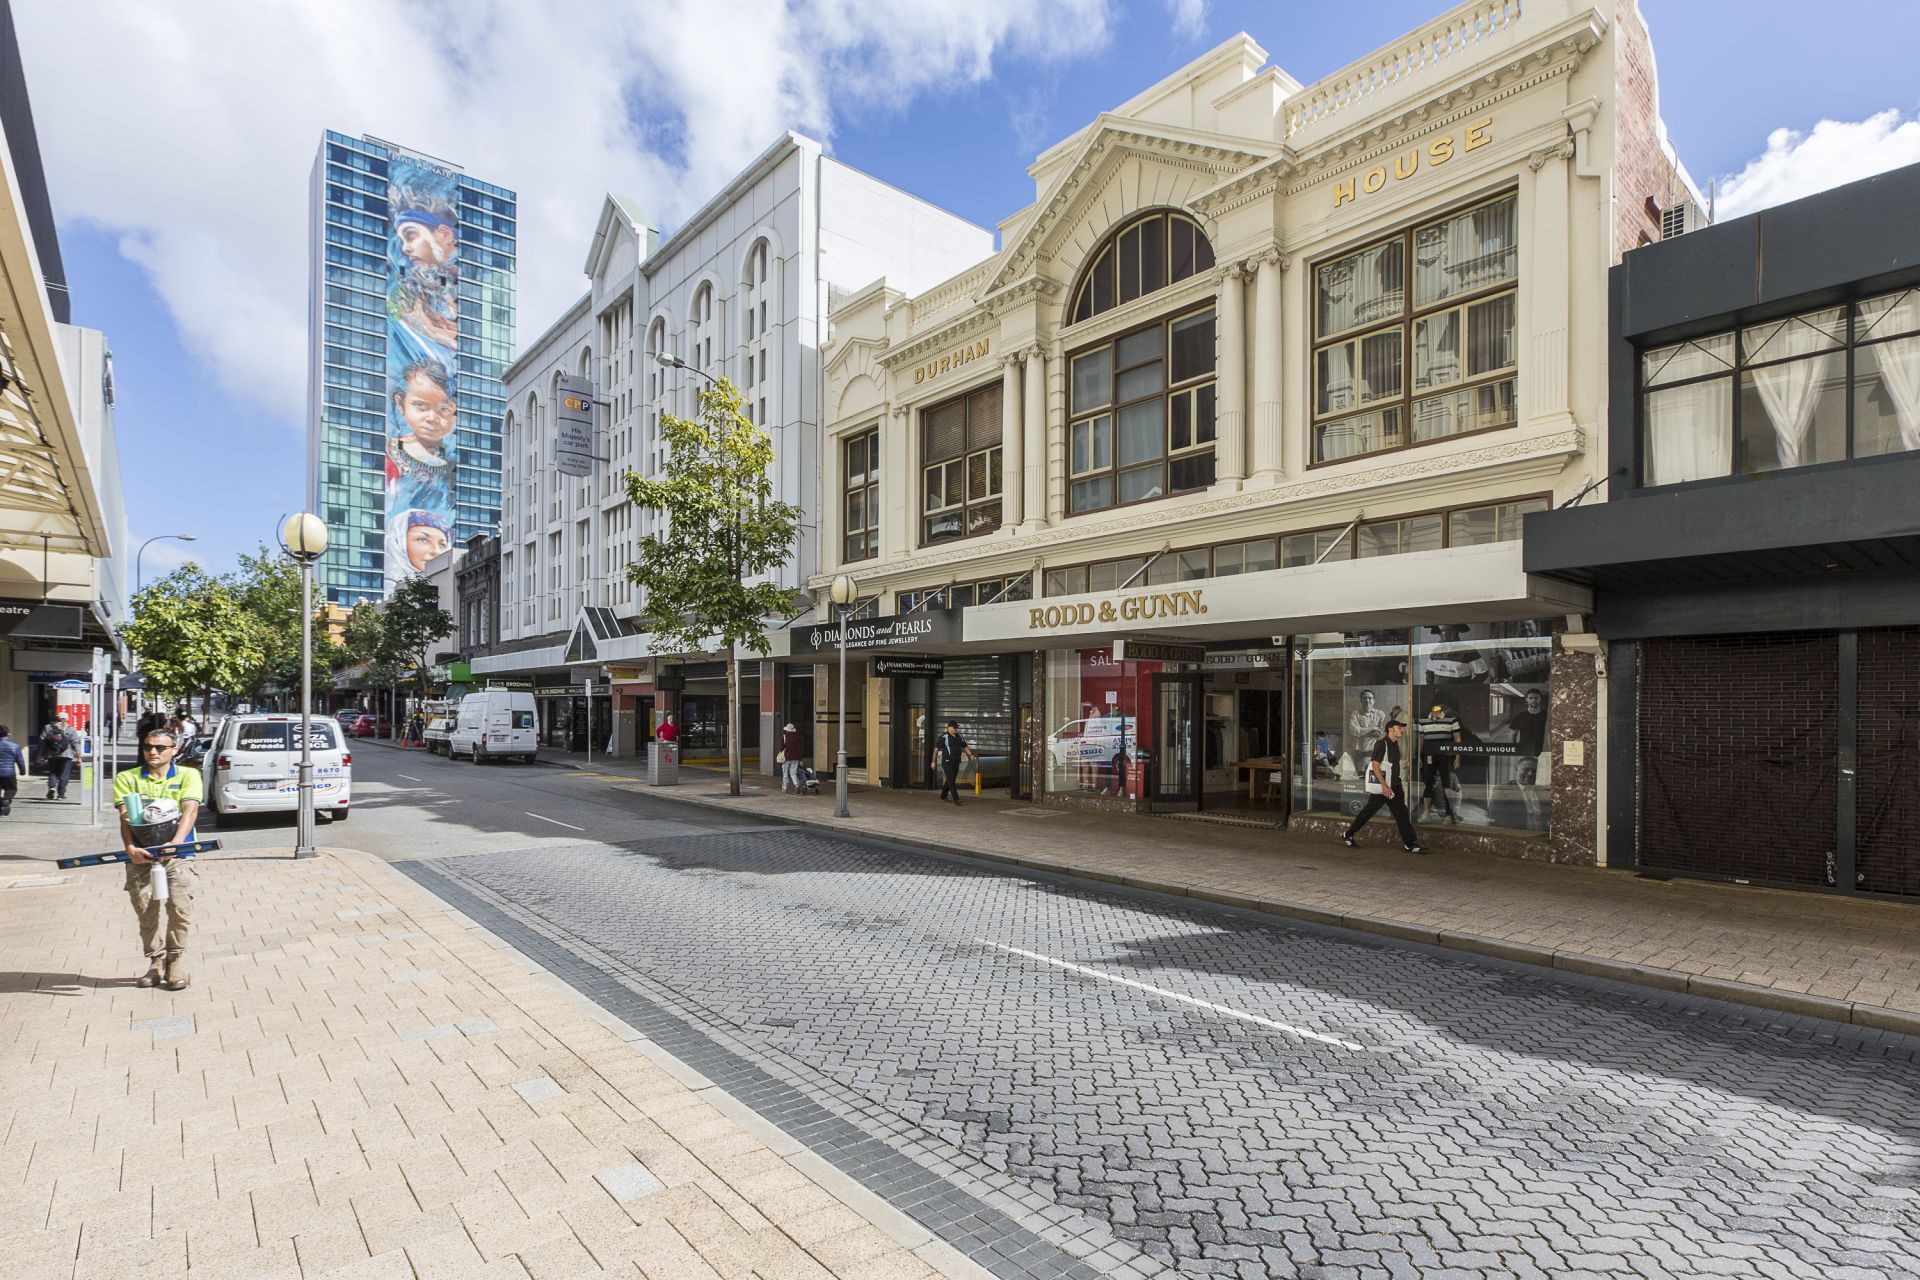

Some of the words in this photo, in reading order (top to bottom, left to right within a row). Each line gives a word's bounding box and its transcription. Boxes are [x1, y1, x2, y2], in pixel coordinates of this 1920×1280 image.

[1333, 117, 1493, 208] HOUSE
[914, 337, 989, 384] DURHAM
[565, 398, 590, 411] CPP
[1029, 603, 1095, 629] RODD
[1098, 600, 1117, 623] &
[1120, 590, 1208, 620] GUNN.
[876, 621, 895, 635] and
[895, 619, 932, 635] PEARLS
[888, 636, 918, 645] JEWELLERY
[1127, 644, 1155, 658] RODD
[1206, 655, 1235, 664] RODD
